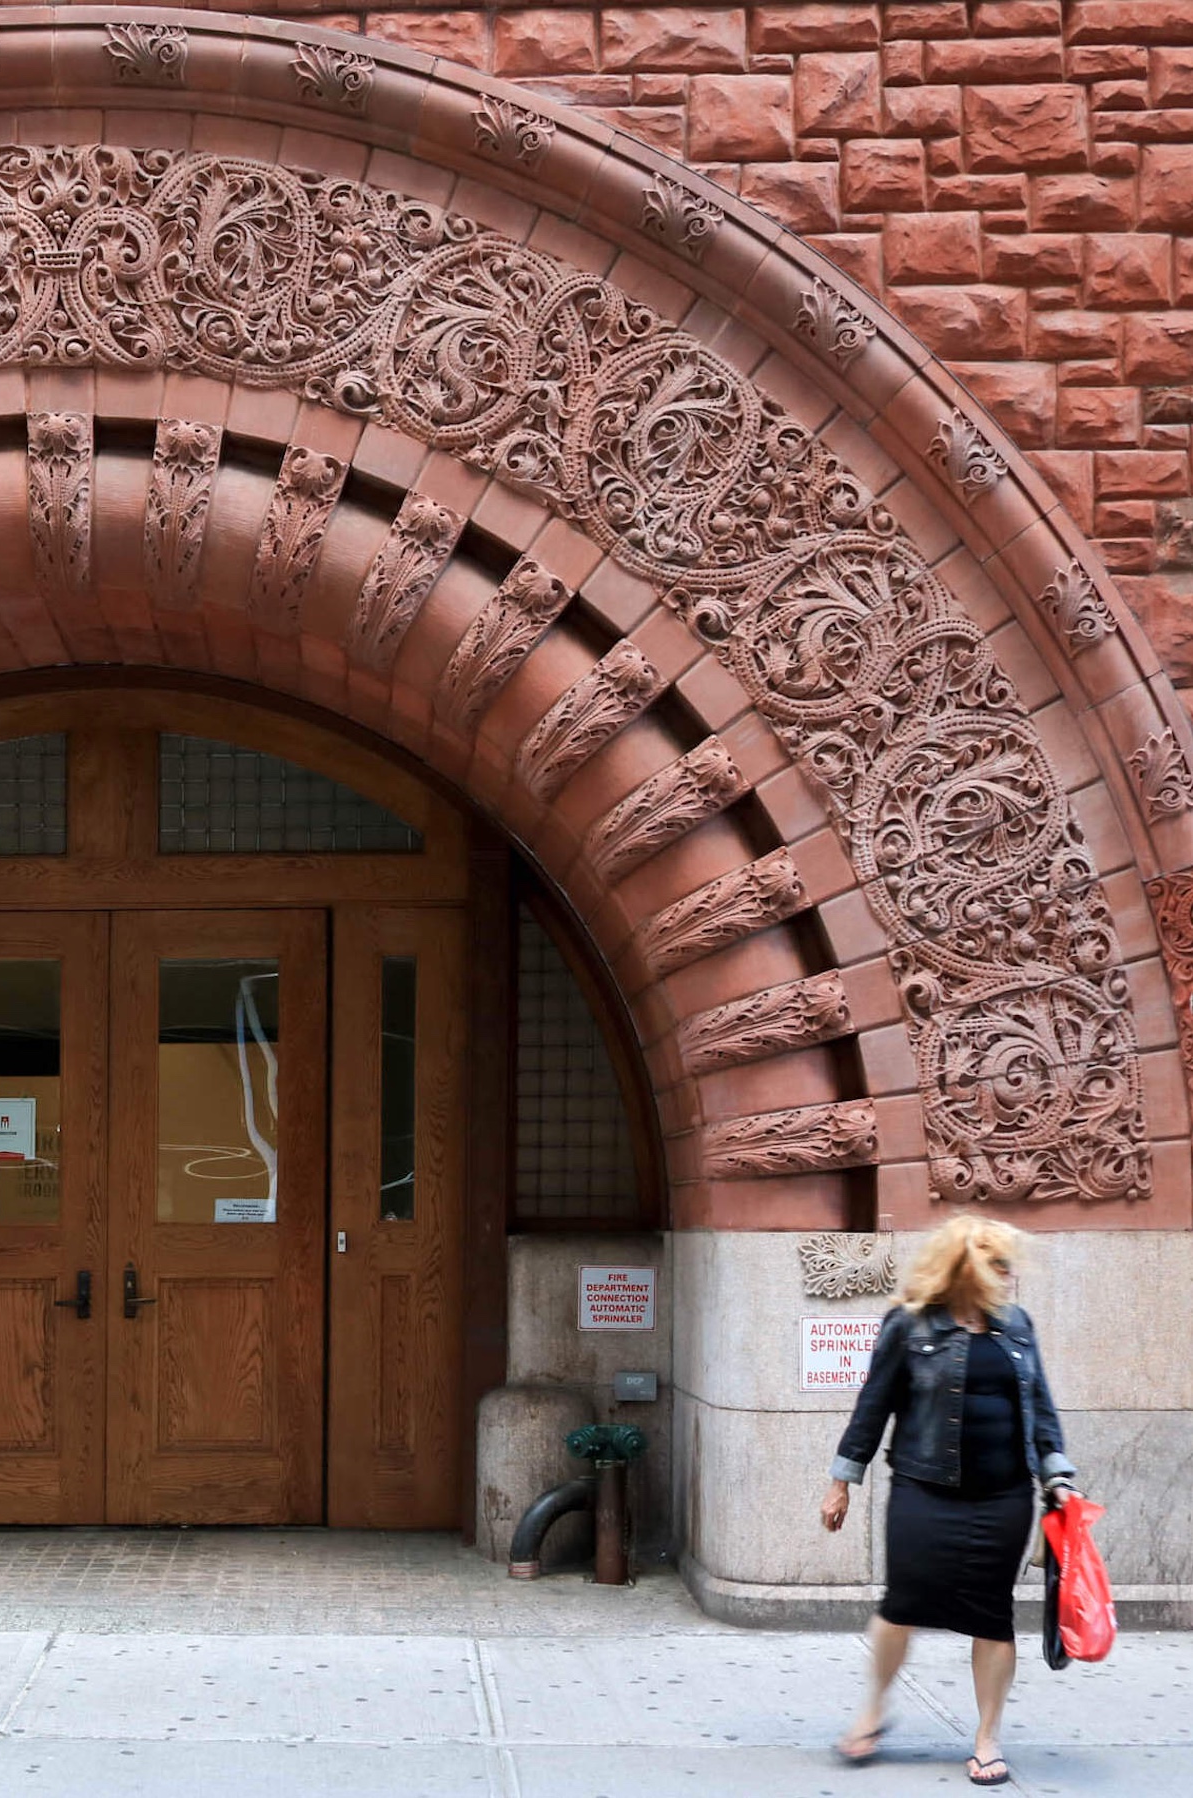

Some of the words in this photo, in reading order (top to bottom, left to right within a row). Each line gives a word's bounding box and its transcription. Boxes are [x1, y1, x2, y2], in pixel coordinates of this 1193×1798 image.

[608, 1273, 629, 1282] FIRE
[586, 1284, 650, 1292] DEPARTMENT
[586, 1294, 649, 1303] CONNECTION
[589, 1304, 647, 1313] AUTOMATIC
[592, 1314, 644, 1323] SPRINKLER
[810, 1322, 881, 1336] AUTOMATIC
[839, 1355, 852, 1368] IN
[807, 1371, 857, 1384] BASEMENT
